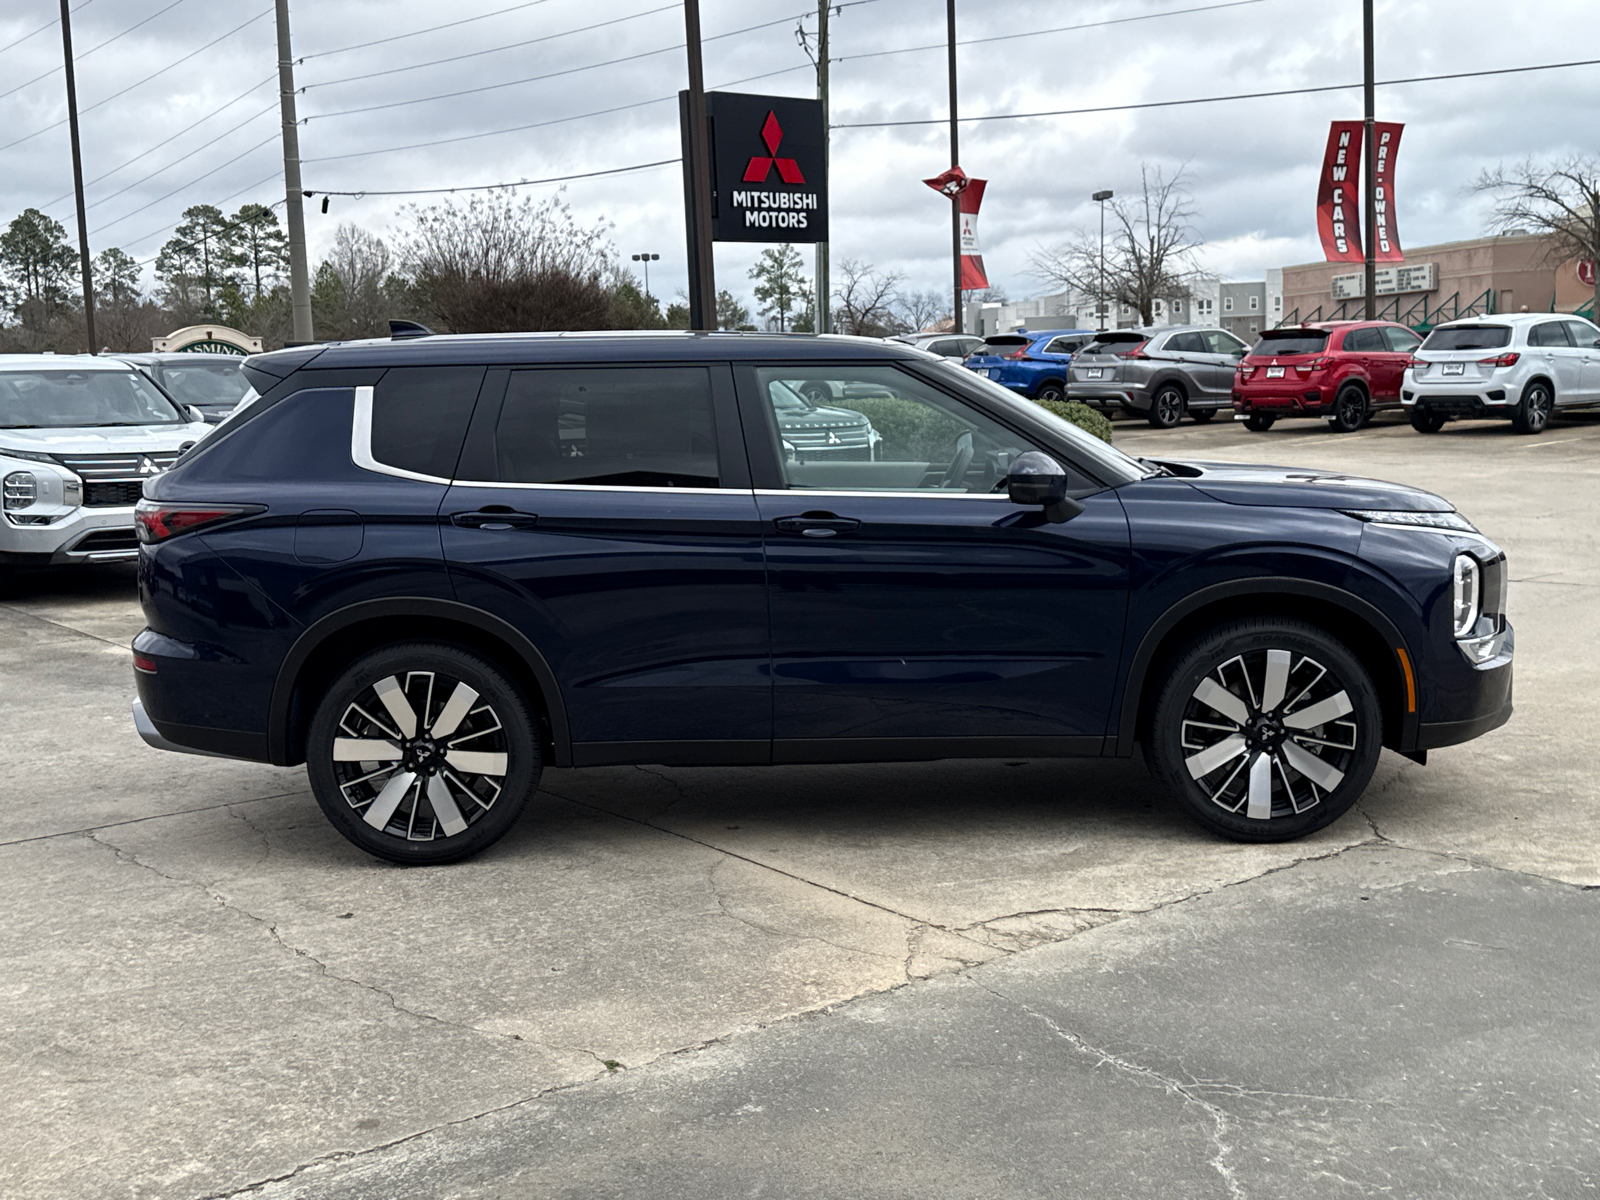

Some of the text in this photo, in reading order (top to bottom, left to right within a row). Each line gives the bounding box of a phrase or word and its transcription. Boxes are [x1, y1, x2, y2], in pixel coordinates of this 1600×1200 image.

[1333, 131, 1351, 182] NEW
[732, 190, 817, 209] MITSUBISHI
[745, 210, 808, 228] MOTORS
[1333, 188, 1349, 253] CARS
